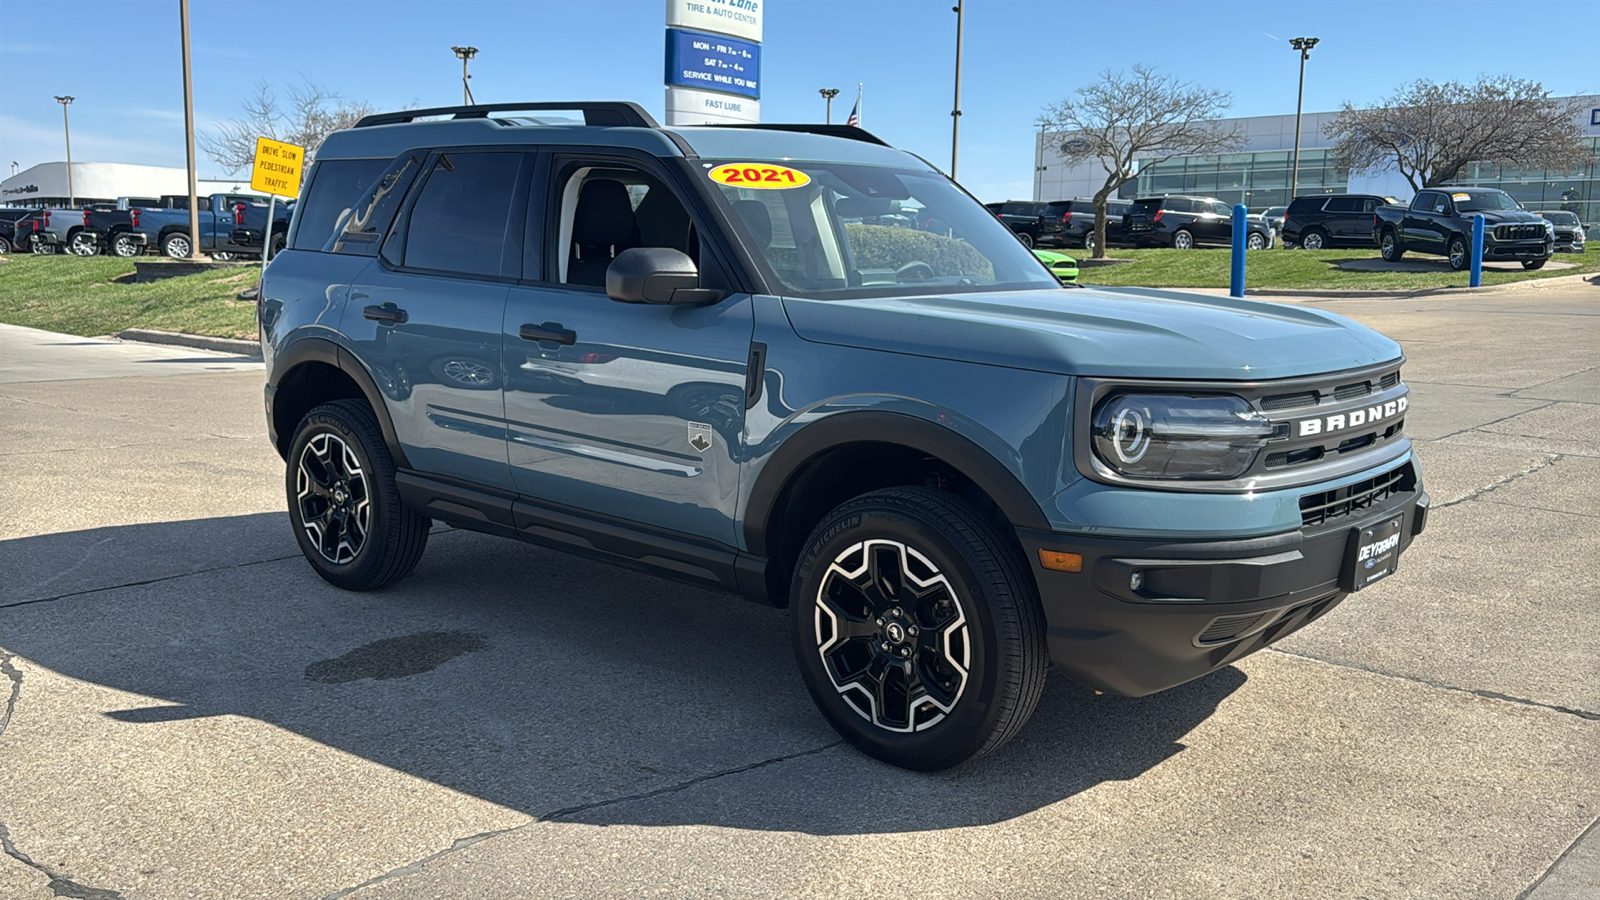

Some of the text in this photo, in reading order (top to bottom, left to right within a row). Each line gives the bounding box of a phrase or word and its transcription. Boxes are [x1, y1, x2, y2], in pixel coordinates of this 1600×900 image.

[686, 3, 757, 25] TIRE & AUTO CENTER
[693, 41, 710, 51] MON
[717, 45, 727, 54] FRI
[704, 58, 717, 67] SAT
[683, 70, 757, 89] SERVICE WHILE YOU WAIT
[705, 99, 742, 112] FAST LUBE
[262, 145, 297, 161] DRIVE SLOW
[260, 160, 295, 175] PEDESTRIAN
[722, 168, 797, 183] 2021
[265, 177, 288, 190] TRAFFIC
[1299, 397, 1409, 437] BRONCO
[812, 515, 860, 554] MICHELIN
